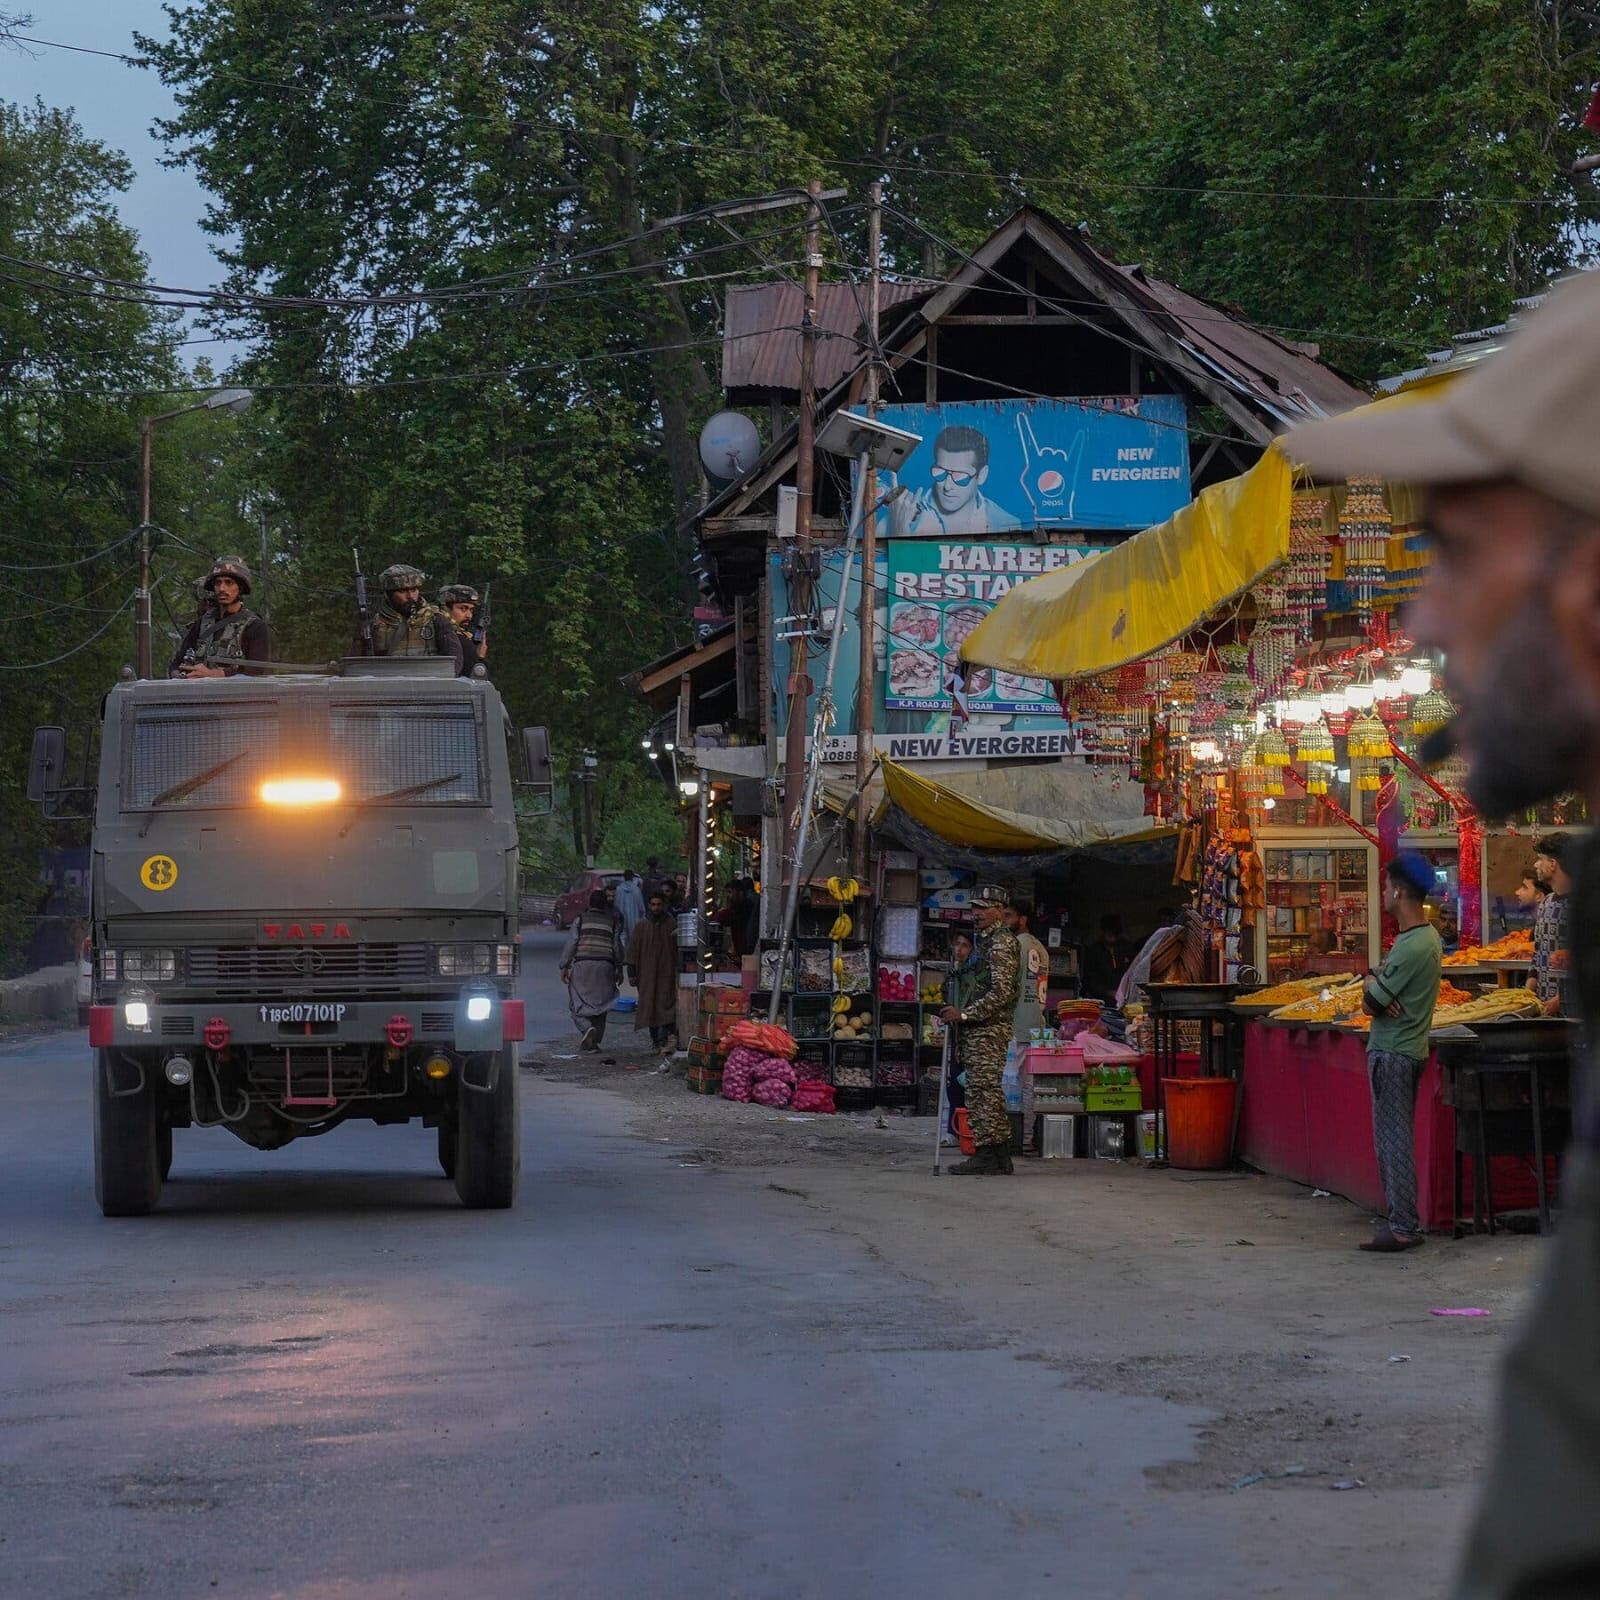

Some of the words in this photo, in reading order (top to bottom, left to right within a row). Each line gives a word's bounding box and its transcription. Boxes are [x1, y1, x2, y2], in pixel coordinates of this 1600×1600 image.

[1117, 448, 1154, 461] NEW
[1091, 466, 1180, 481] EVERGREEN
[895, 572, 1040, 600] RESTA
[916, 701, 939, 709] ROAD
[890, 738, 942, 757] NEW
[950, 735, 1077, 755] EVERGREEN
[149, 859, 172, 884] 8
[262, 922, 352, 940] TATA
